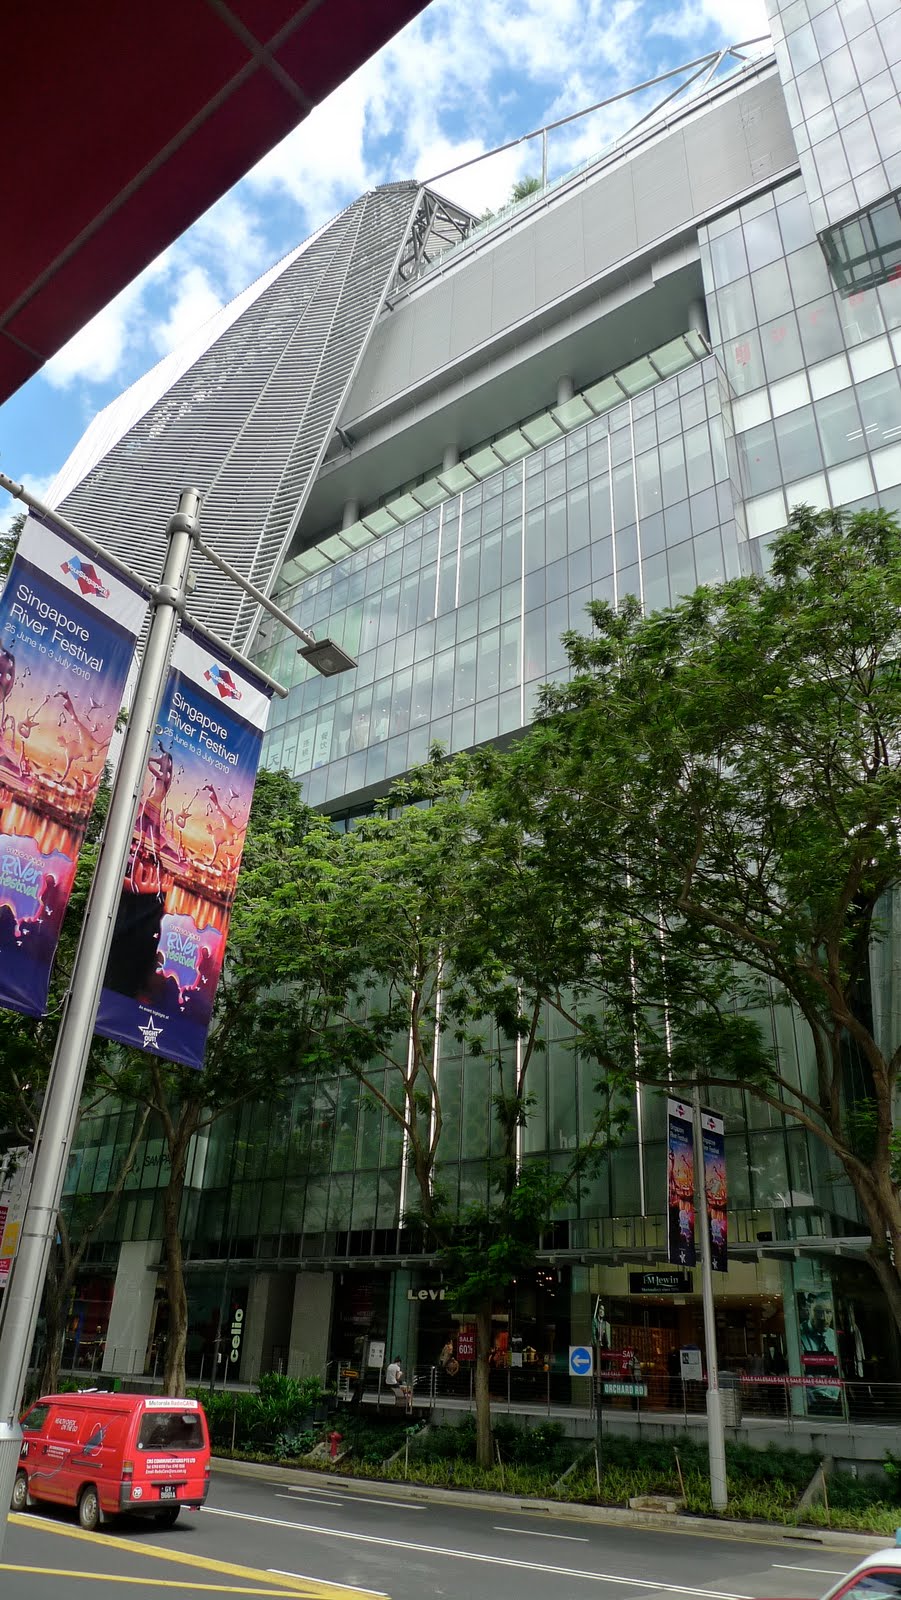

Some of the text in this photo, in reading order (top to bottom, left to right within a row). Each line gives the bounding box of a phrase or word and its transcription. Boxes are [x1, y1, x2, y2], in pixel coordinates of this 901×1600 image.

[10, 603, 104, 672] River Festival
[17, 585, 90, 641] Singapore
[4, 622, 91, 681] 25 June to 3 July 2010
[167, 709, 239, 765] River Festival
[172, 692, 228, 739] Singapore
[163, 727, 174, 737] 25
[174, 734, 189, 748] June
[189, 743, 196, 753] to
[202, 753, 215, 765] July
[215, 761, 230, 774] 2010
[230, 1308, 244, 1363] celio
[458, 1344, 474, 1354] 60%
[604, 1384, 644, 1395] ORCHARD RD
